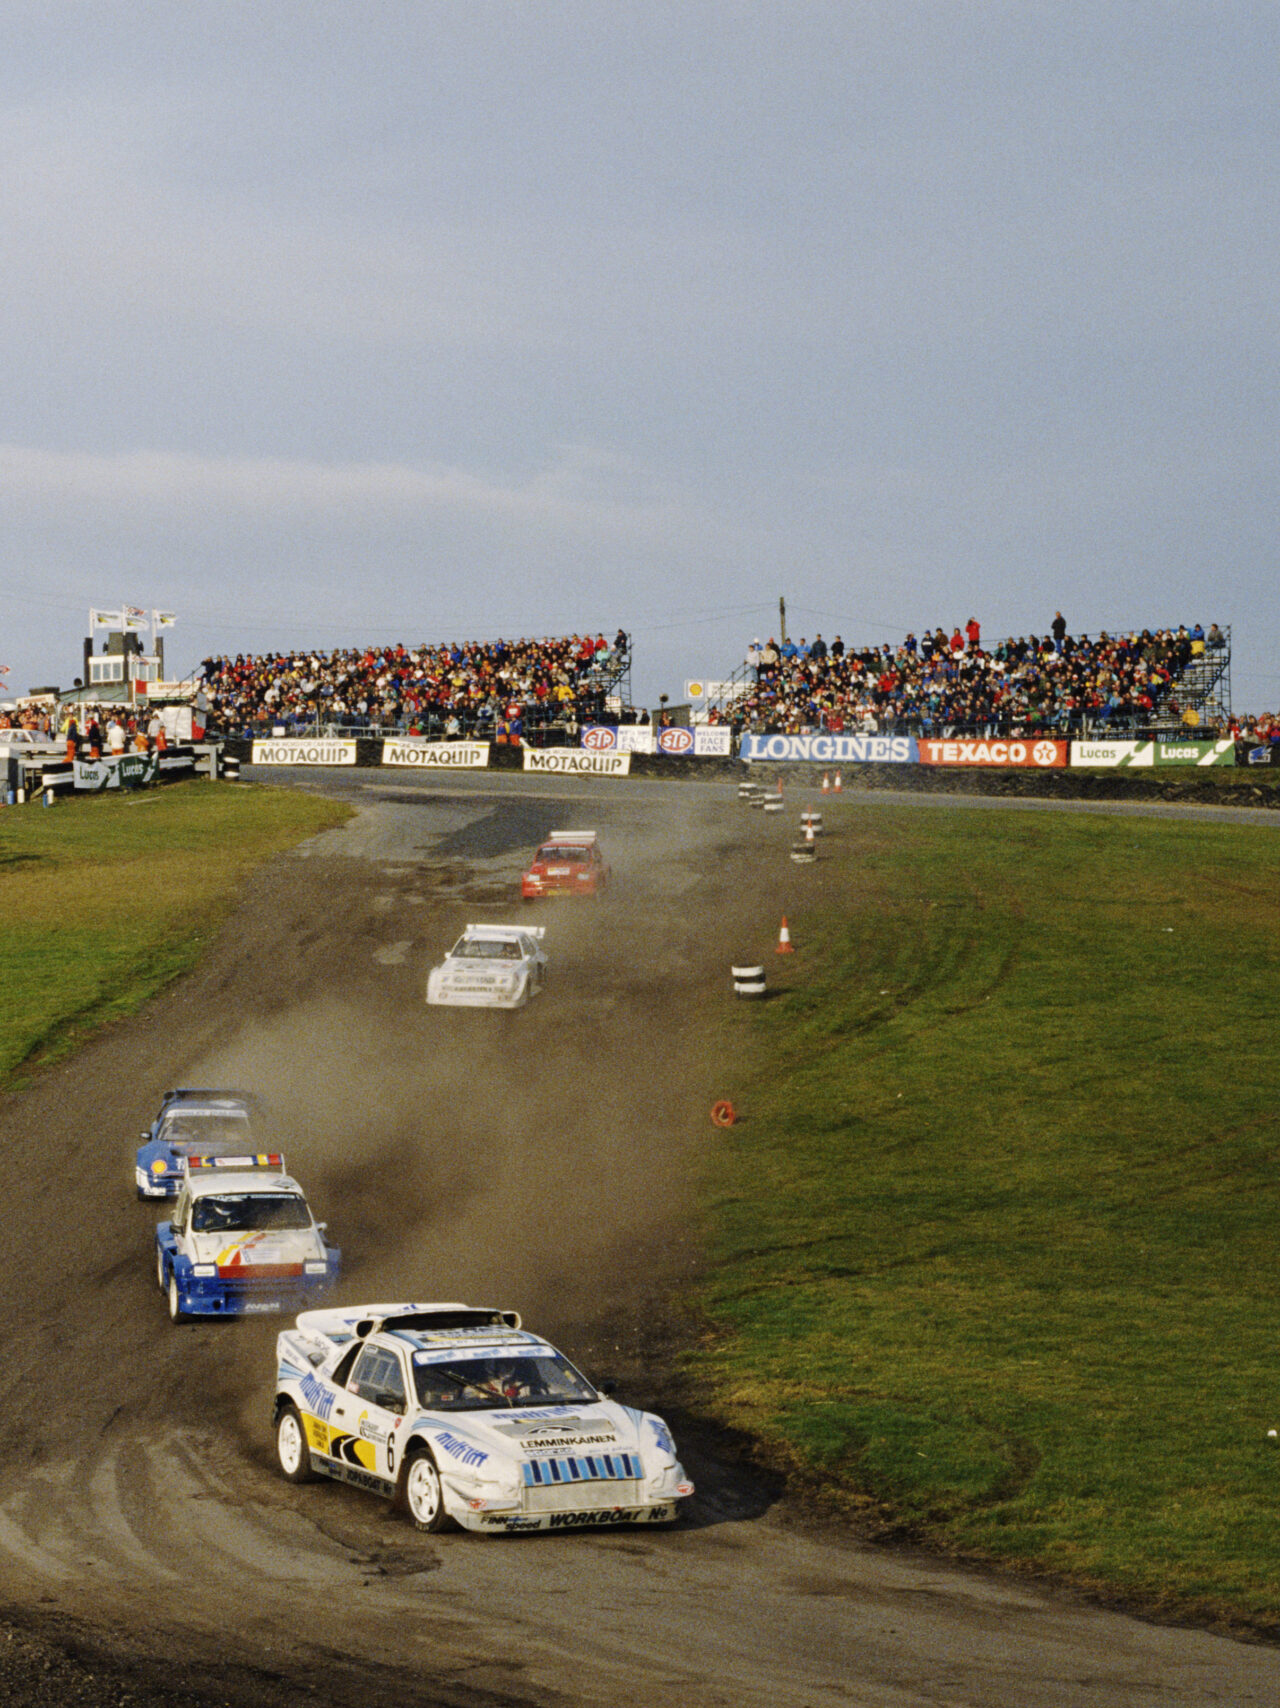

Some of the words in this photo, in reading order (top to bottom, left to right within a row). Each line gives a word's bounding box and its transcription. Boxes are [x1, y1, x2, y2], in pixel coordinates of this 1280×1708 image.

[587, 730, 612, 747] STP
[663, 731, 689, 748] STP
[259, 748, 348, 762] MOTAQUIP
[390, 749, 480, 764] MOTAQUIP
[748, 736, 909, 761] LONGINES
[928, 743, 1026, 762] TEXACO
[1080, 746, 1116, 758] Lucas
[1160, 745, 1199, 759] Lucas
[122, 762, 144, 777] Lucas
[530, 755, 622, 772] MOTAQUIP
[80, 766, 99, 780] Lucas
[387, 1431, 395, 1473] 6
